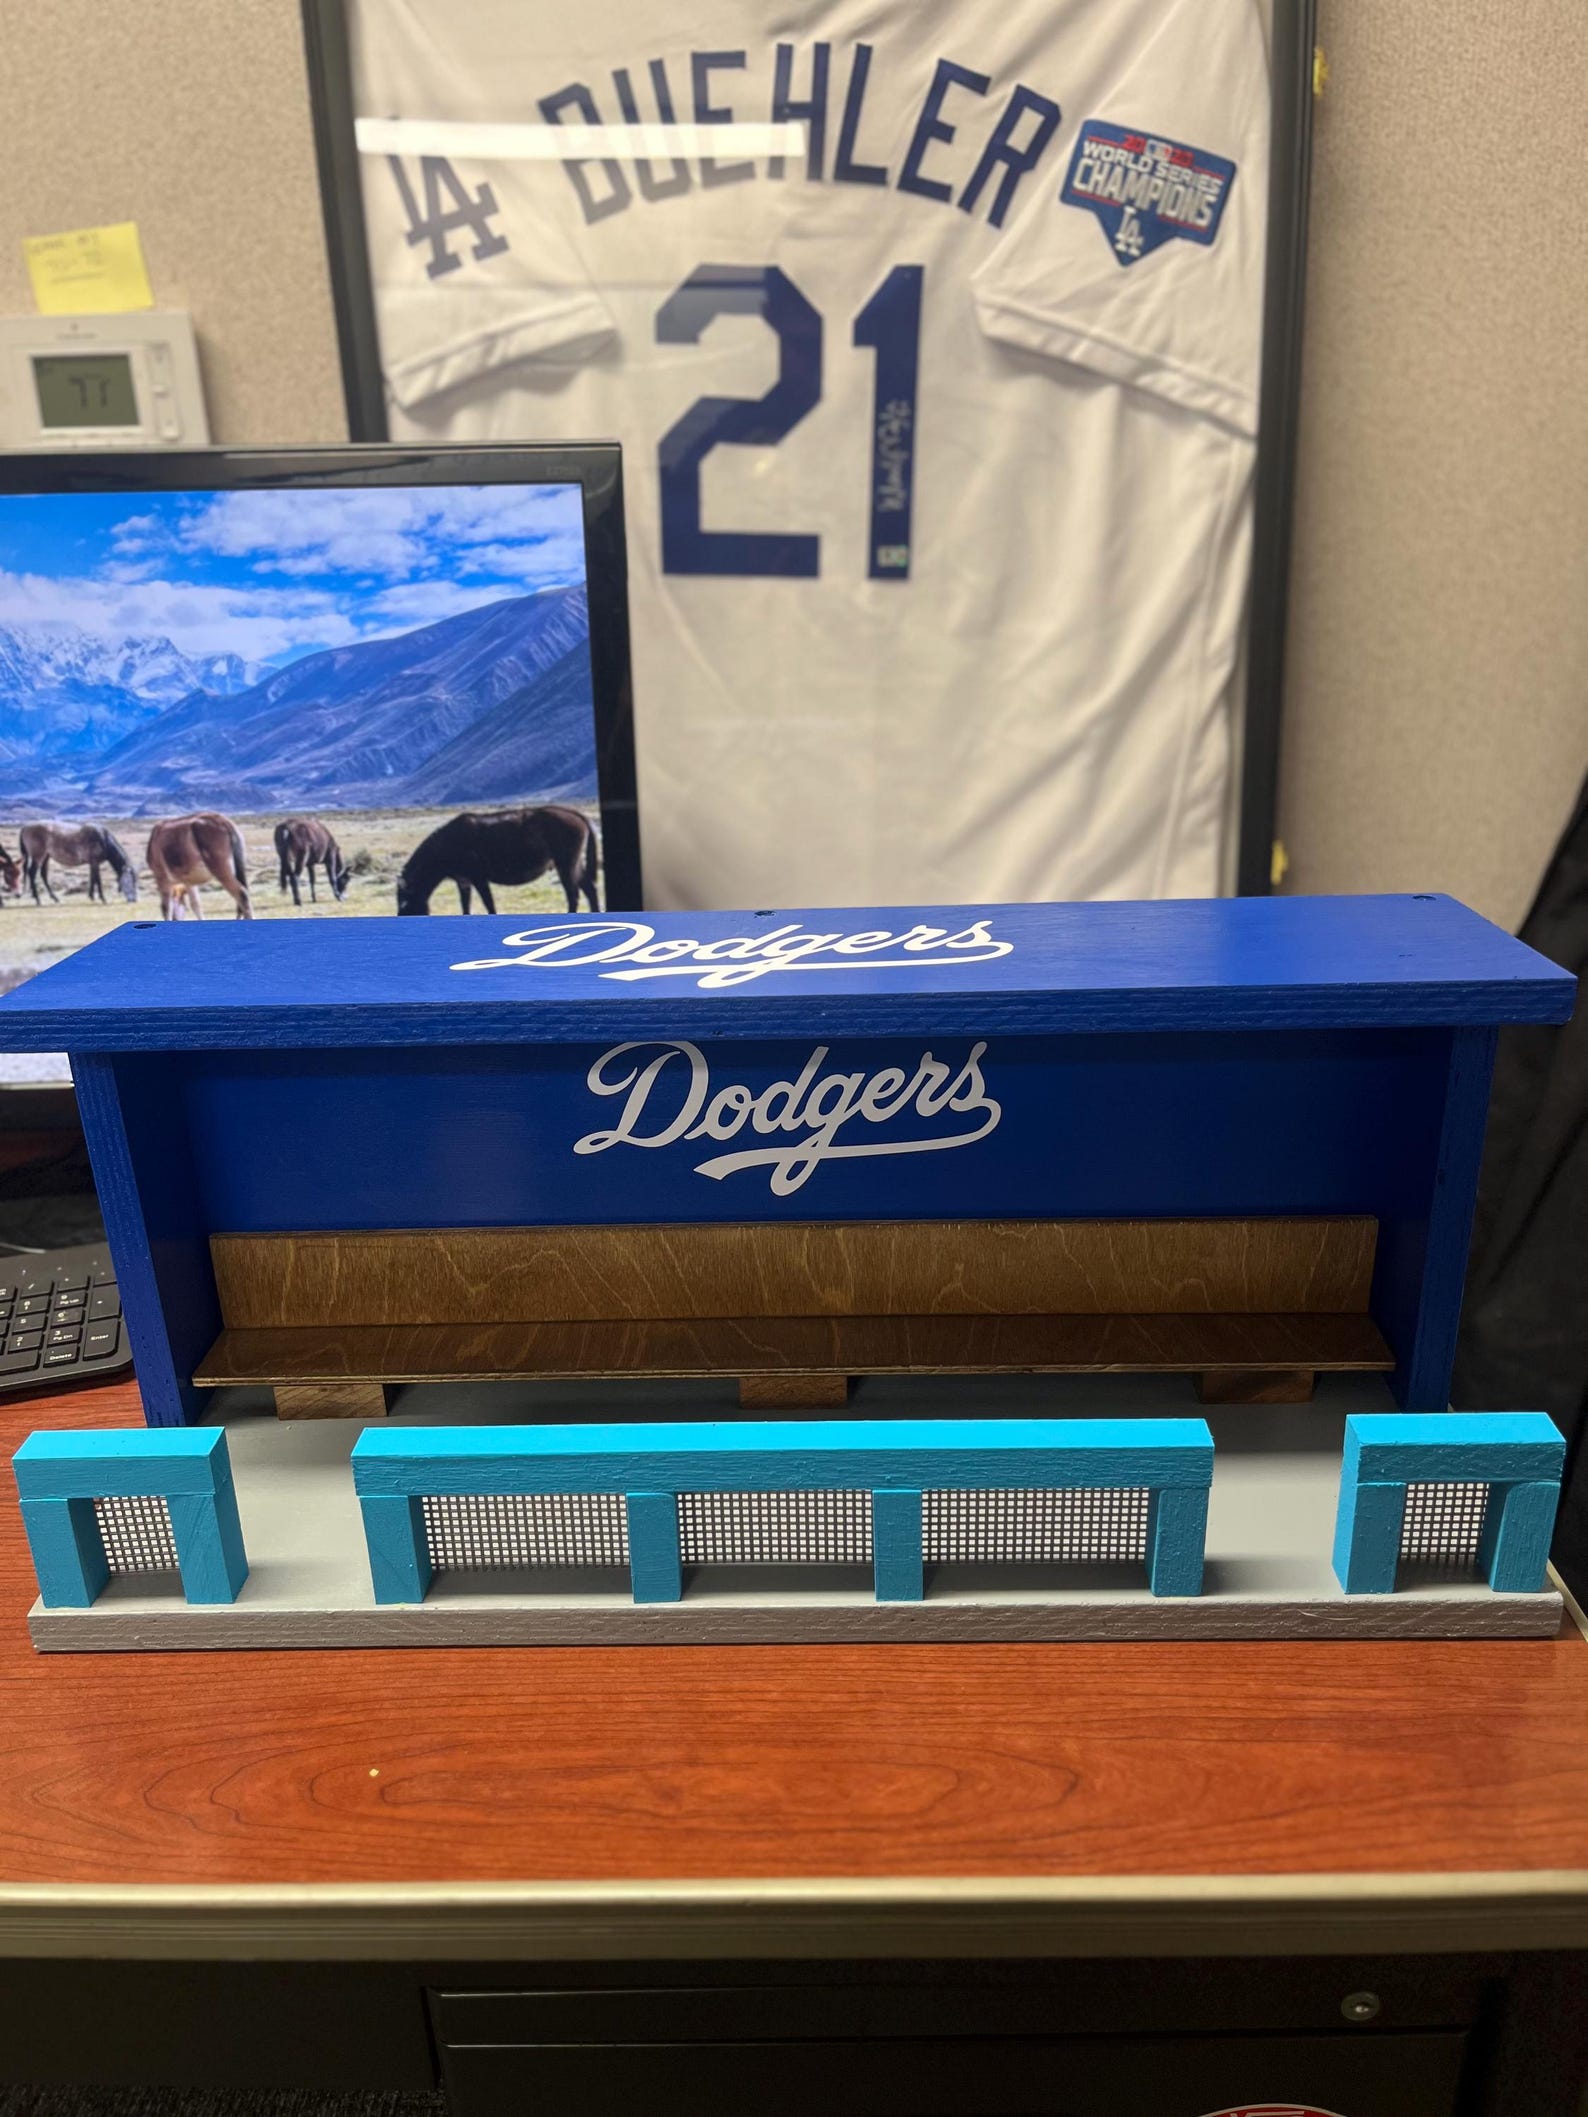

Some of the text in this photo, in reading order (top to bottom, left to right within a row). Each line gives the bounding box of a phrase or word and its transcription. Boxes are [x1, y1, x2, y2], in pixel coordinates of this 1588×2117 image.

[537, 42, 1062, 229] BUEHLER
[1083, 140, 1224, 196] WORLD SERIES
[386, 116, 510, 281] LA
[1072, 158, 1218, 228] CHAMPIONS
[1114, 205, 1145, 258] LA
[655, 264, 924, 579] 21
[449, 920, 1014, 989] Dodgers
[573, 1041, 1001, 1196] Dodgers
